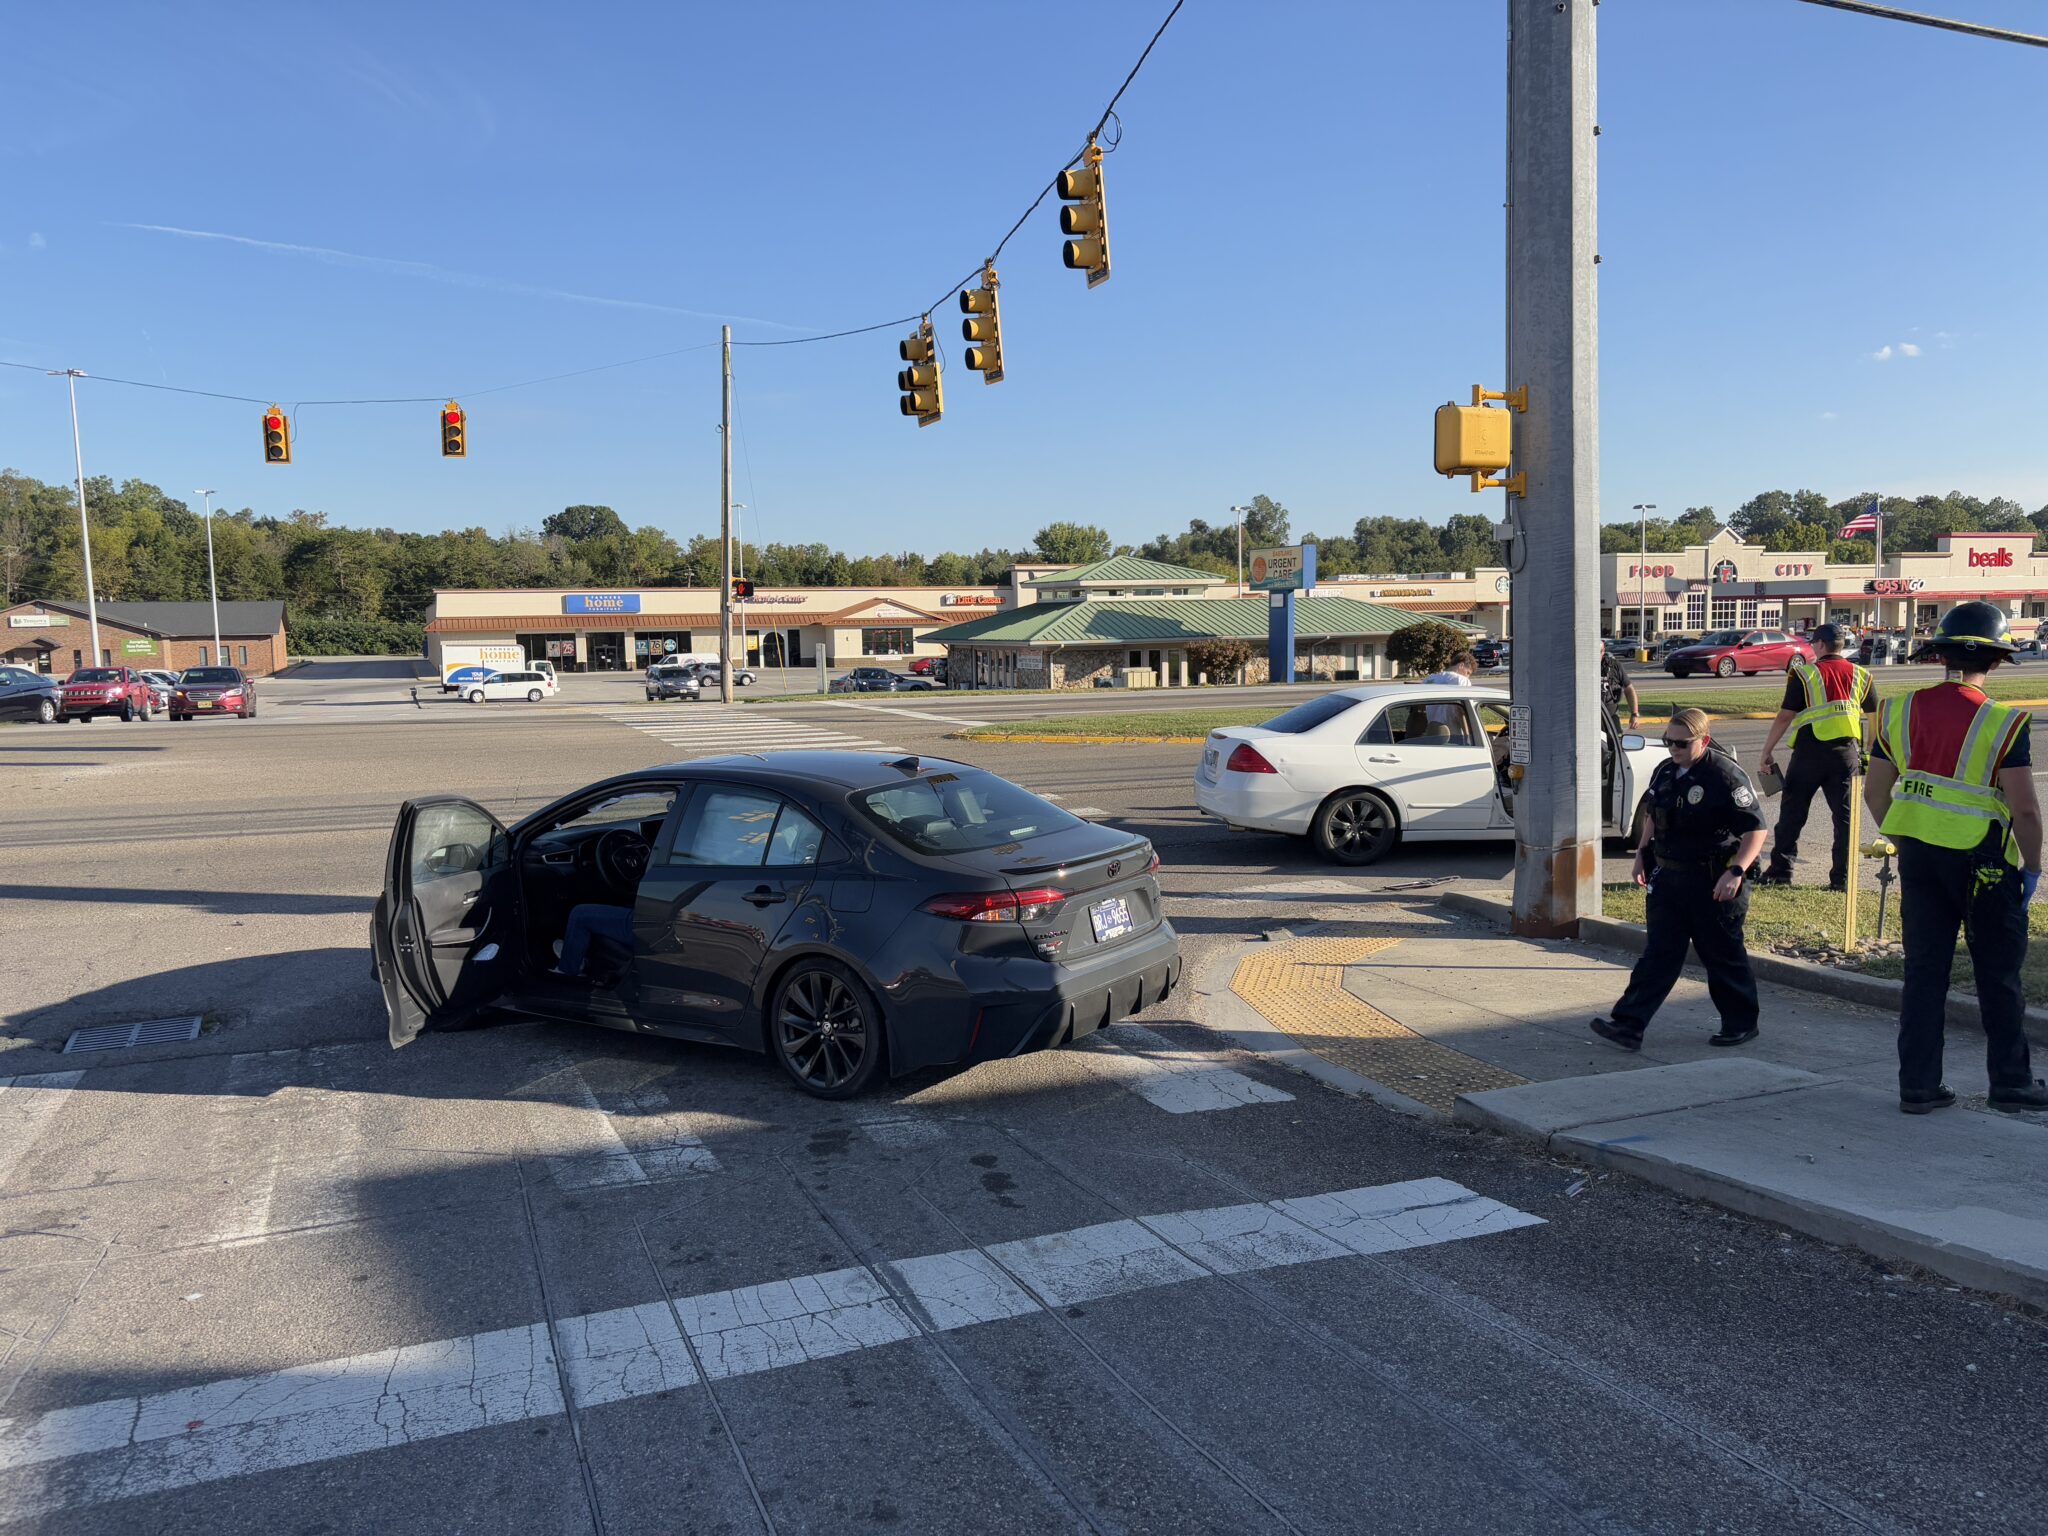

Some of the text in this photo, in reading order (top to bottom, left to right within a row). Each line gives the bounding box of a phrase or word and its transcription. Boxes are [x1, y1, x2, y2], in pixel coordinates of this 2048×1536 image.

[1268, 557, 1297, 569] URGENT
[1968, 547, 2013, 568] bealls
[1273, 569, 1293, 580] CARE
[1629, 563, 1813, 578] FOOD CITY
[585, 595, 624, 608] home
[480, 648, 520, 660] home
[1903, 780, 1934, 798] FIRE
